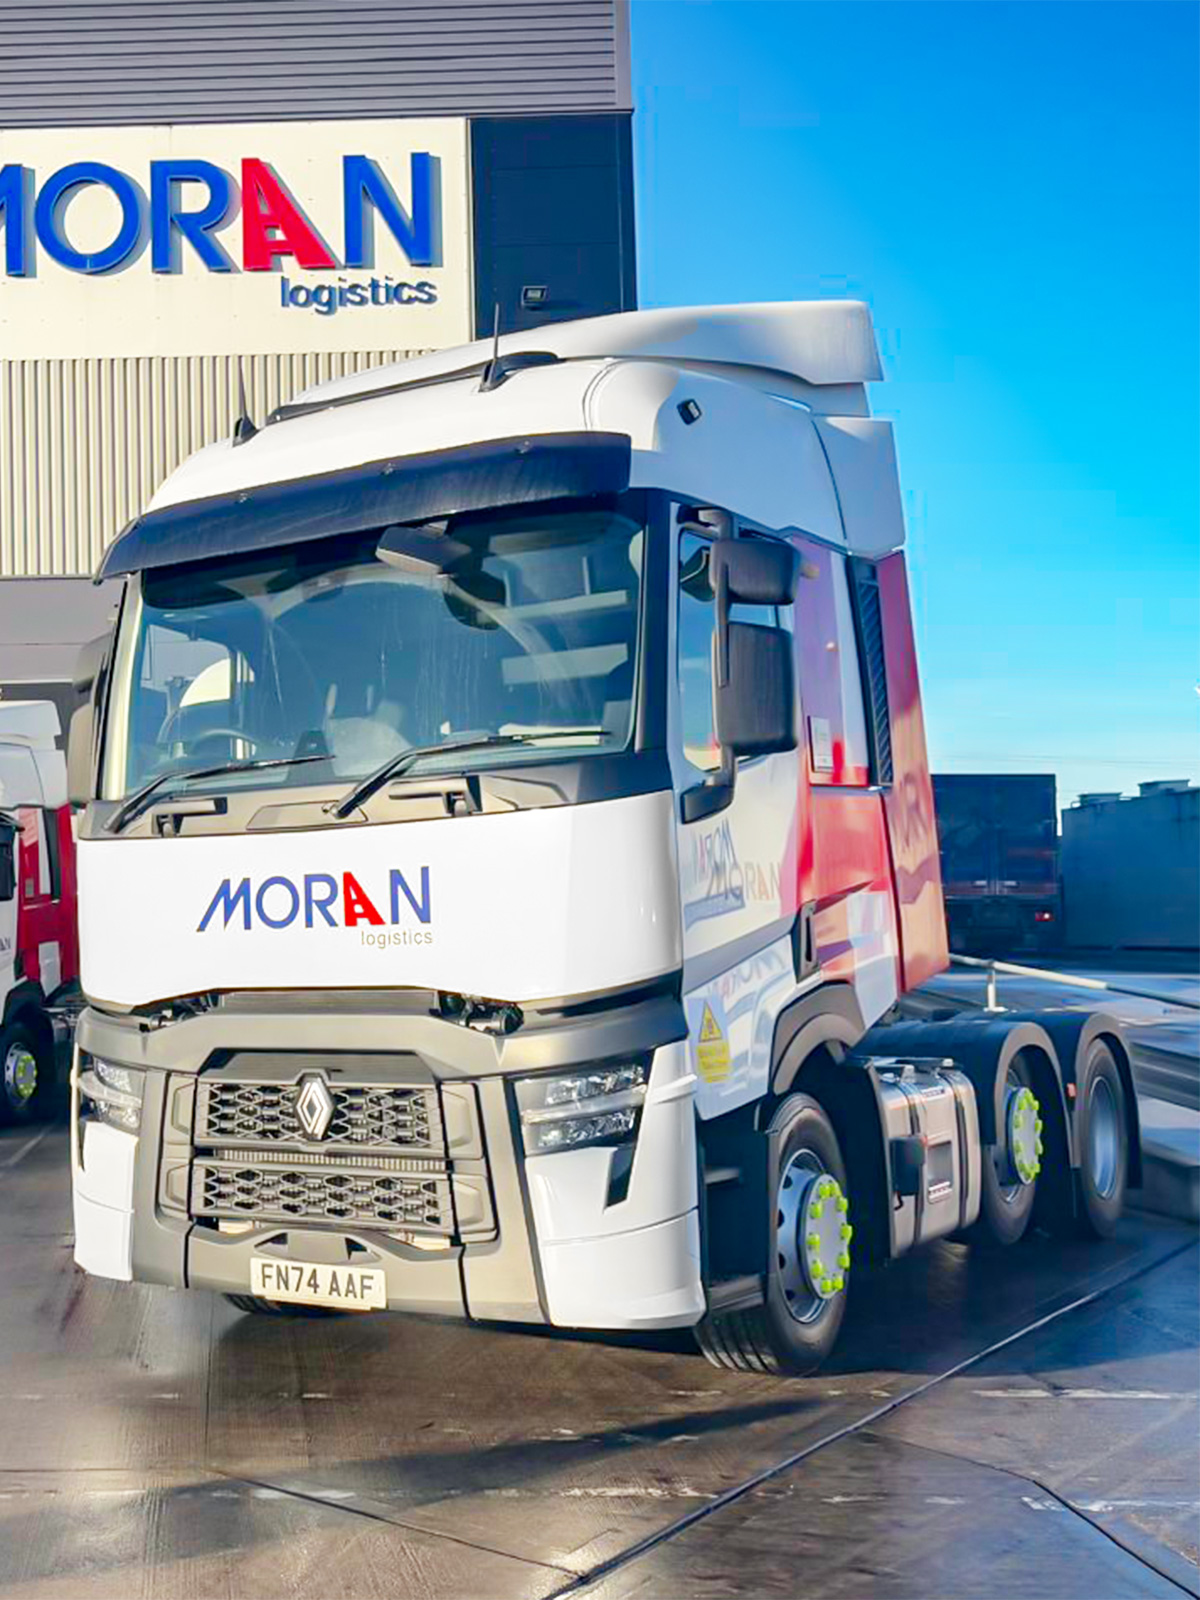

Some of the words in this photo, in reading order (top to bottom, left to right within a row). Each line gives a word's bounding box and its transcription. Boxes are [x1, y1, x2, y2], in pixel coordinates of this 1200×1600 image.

[280, 275, 437, 316] logistics
[196, 865, 432, 933] MORAN
[360, 929, 434, 950] logistics
[261, 1263, 320, 1295] FN74
[328, 1269, 374, 1300] AAF
